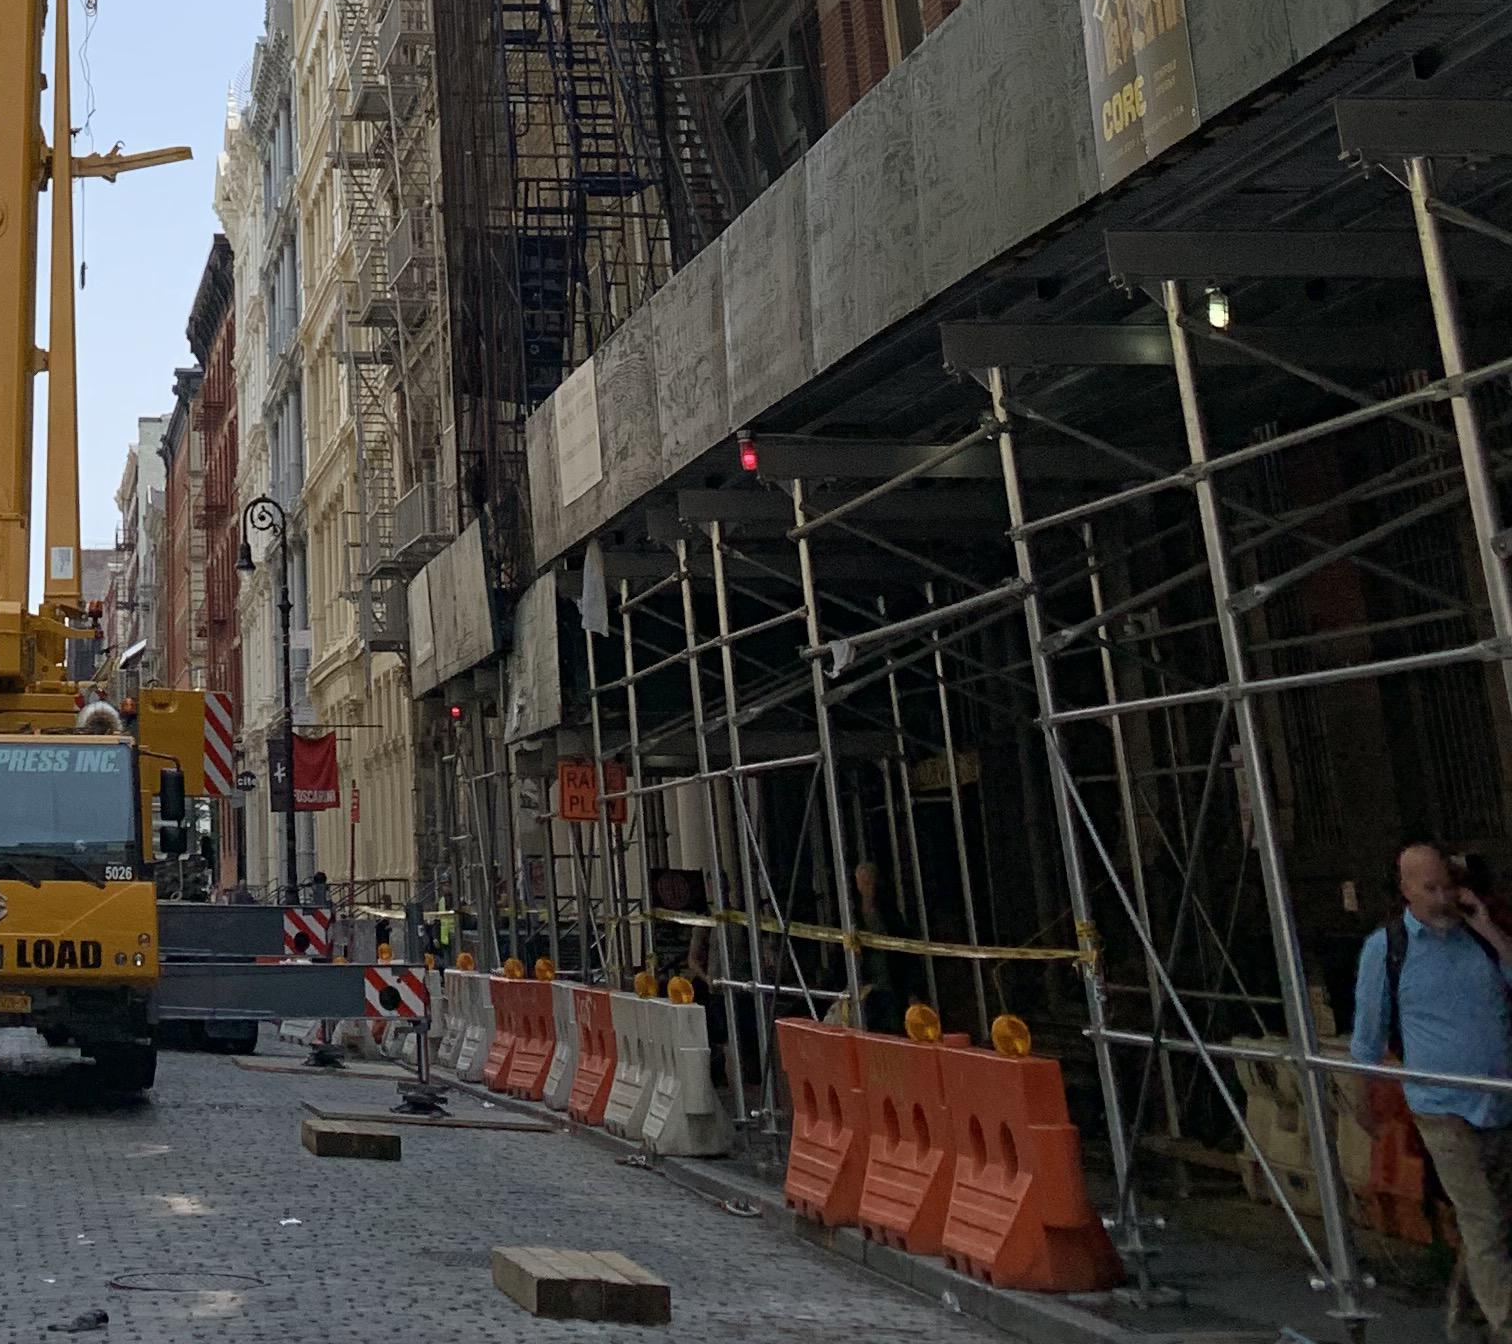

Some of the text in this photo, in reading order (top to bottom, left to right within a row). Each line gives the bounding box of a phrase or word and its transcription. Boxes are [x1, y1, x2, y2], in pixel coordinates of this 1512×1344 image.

[1102, 74, 1148, 143] CORE
[75, 750, 120, 773] INC.
[105, 866, 133, 881] 5026
[16, 939, 102, 969] LOAD
